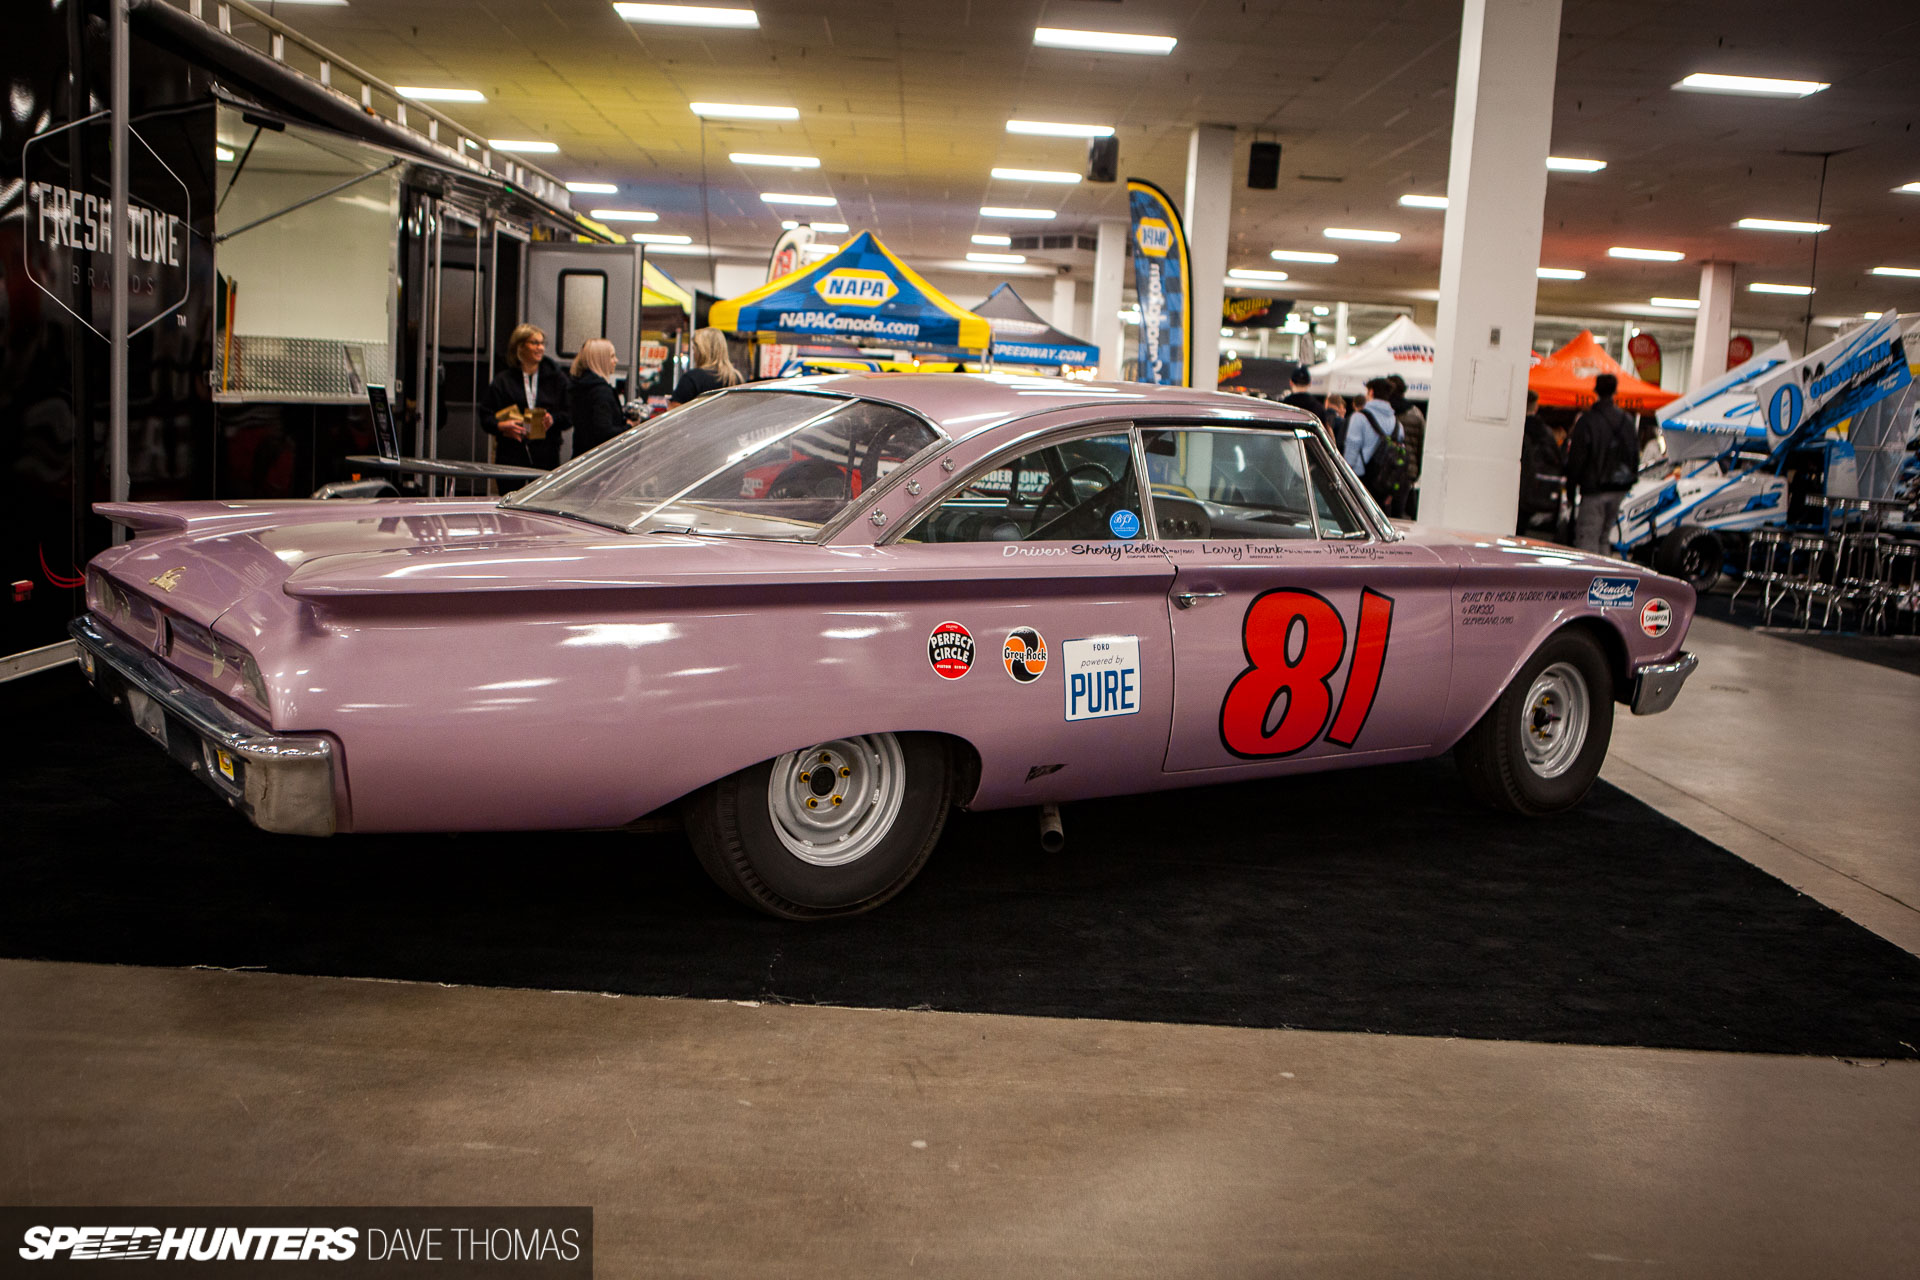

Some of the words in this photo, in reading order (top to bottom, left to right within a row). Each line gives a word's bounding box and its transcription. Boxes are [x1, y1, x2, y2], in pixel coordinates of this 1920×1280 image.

[38, 181, 180, 267] FRESHTONE
[71, 264, 154, 295] BRADS
[828, 278, 884, 298] NAPA
[778, 311, 920, 337] NAPACanada.com
[1809, 338, 1892, 400] OHSWEKEN
[980, 469, 1050, 485] NDERON'S
[1002, 544, 1068, 558] Driver:
[1071, 543, 1121, 561] Shorty
[1121, 543, 1169, 556] Rollins
[1202, 543, 1244, 561] Larry
[1245, 543, 1285, 555] Frank
[1461, 591, 1484, 603] BUILT
[1484, 591, 1495, 603] BY
[1495, 591, 1516, 603] HERB
[1544, 590, 1559, 602] FOR
[1468, 604, 1495, 615] RUSSO
[1645, 615, 1668, 623] CHAMPION
[929, 632, 974, 650] PERFECT
[1093, 643, 1110, 652] FORD
[933, 645, 970, 663] CIRCLE
[1004, 647, 1047, 662] Grey-Rock
[1080, 656, 1113, 668] powered
[1115, 655, 1125, 665] by
[1218, 584, 1395, 761] 81
[1070, 669, 1135, 716] PURE
